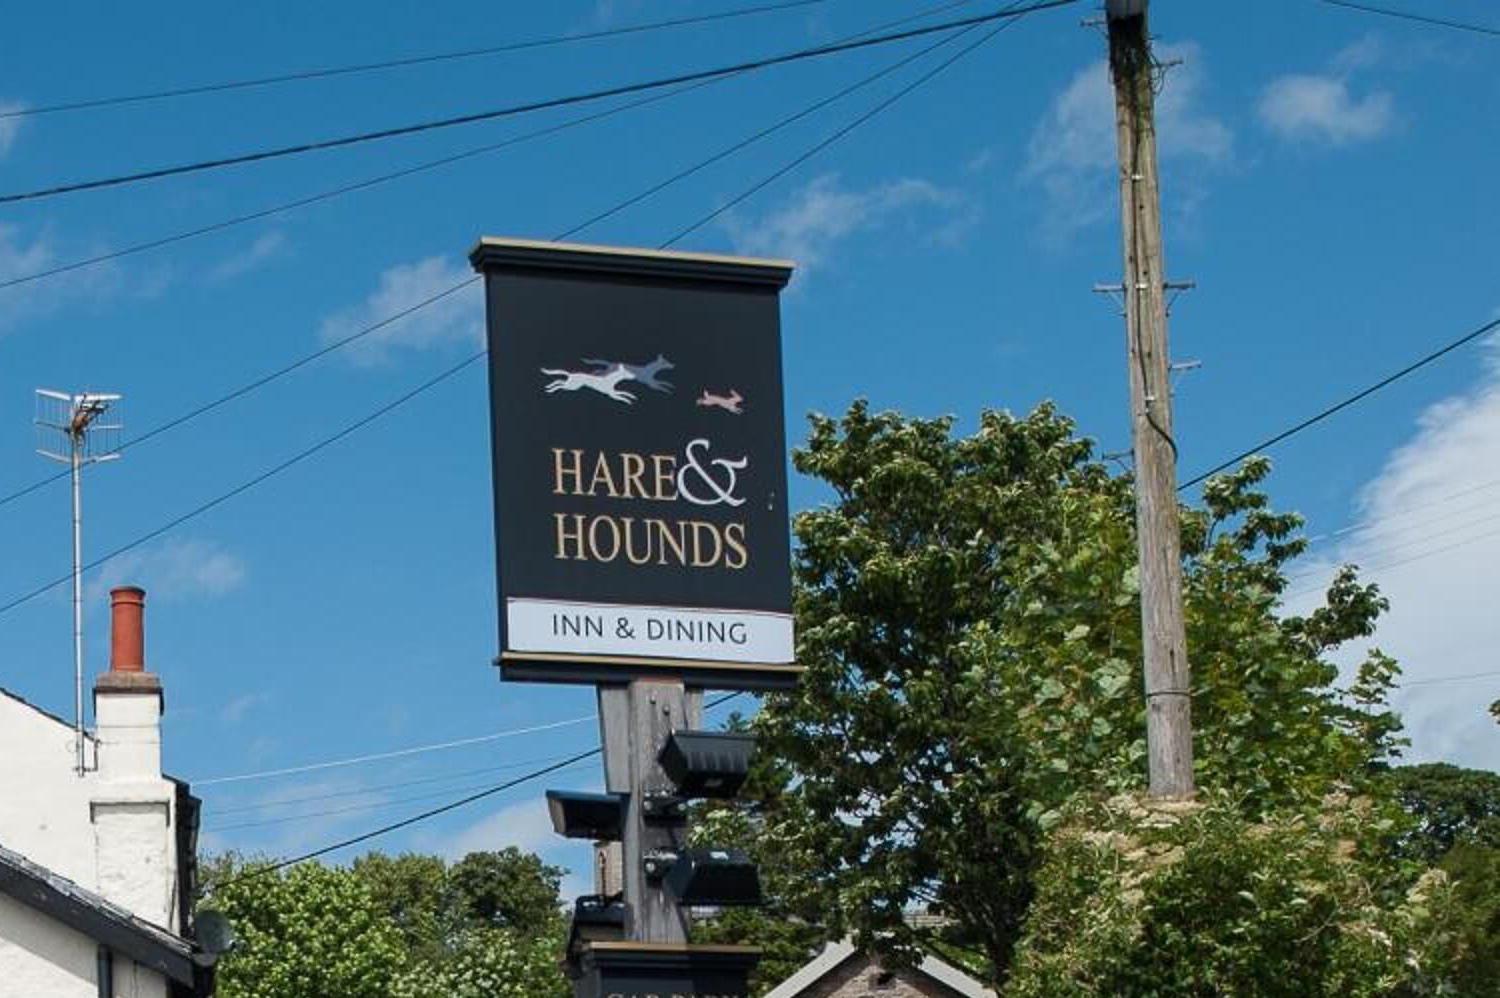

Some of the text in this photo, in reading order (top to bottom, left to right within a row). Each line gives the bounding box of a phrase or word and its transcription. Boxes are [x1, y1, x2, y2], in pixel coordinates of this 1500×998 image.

[552, 438, 747, 507] HARE &
[553, 513, 748, 569] HOUNDS
[553, 613, 748, 645] INN & DINING
